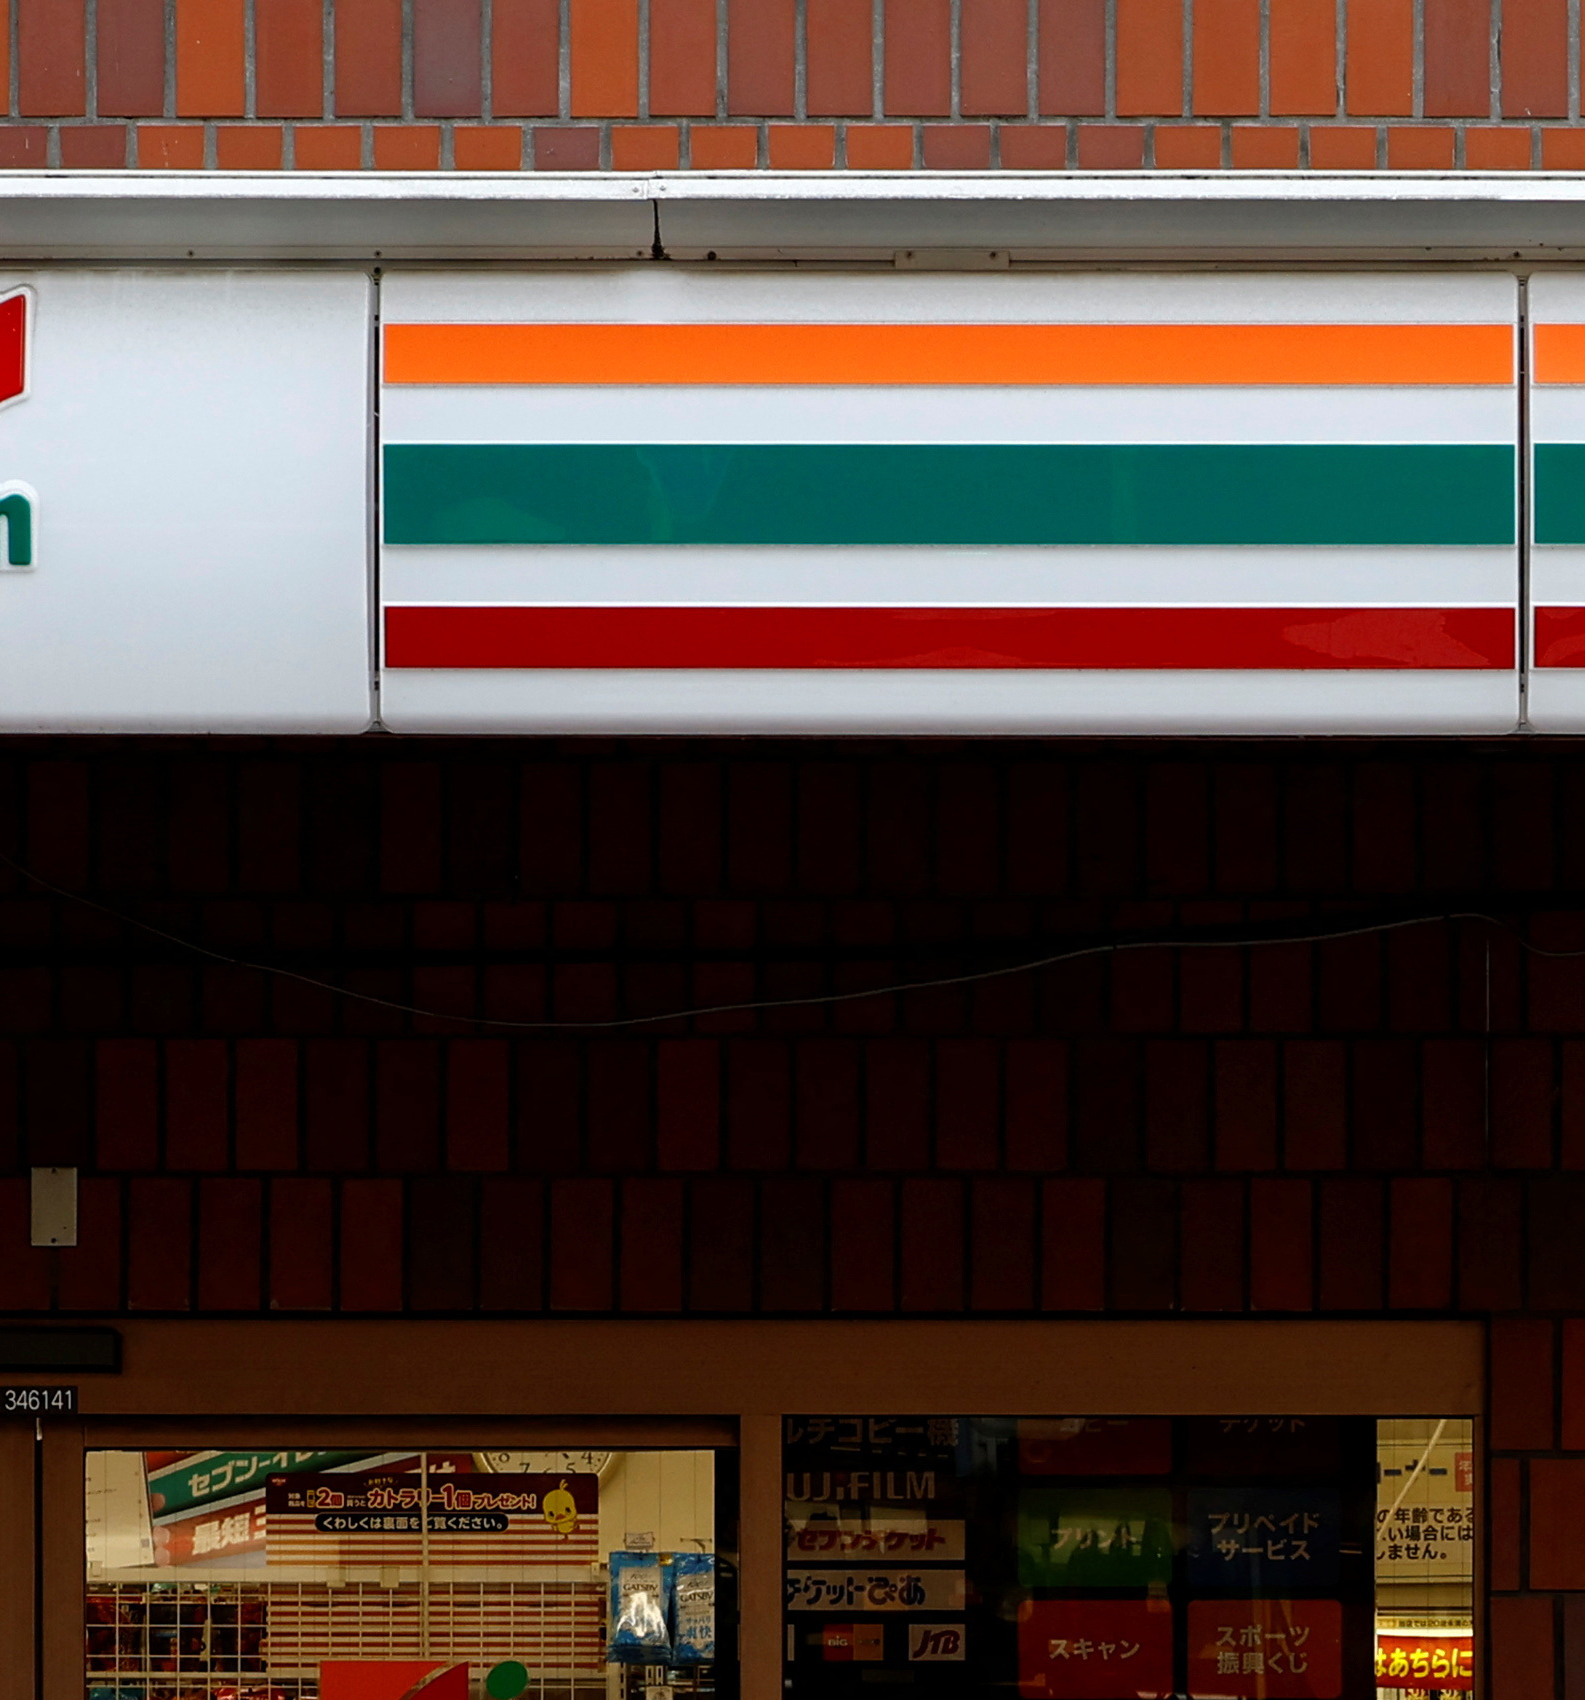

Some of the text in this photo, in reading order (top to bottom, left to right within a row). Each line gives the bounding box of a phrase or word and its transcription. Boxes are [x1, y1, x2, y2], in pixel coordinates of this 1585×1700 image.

[4, 1389, 72, 1411] 346141
[1207, 1512, 1319, 1536] プリペイド
[1051, 1527, 1139, 1550] プリント
[1216, 1538, 1311, 1562] サービス
[913, 1630, 961, 1659] JTB
[1216, 1624, 1310, 1648] スポーツ
[1048, 1638, 1141, 1661] スキャン
[1216, 1650, 1309, 1675] 振興くじ
